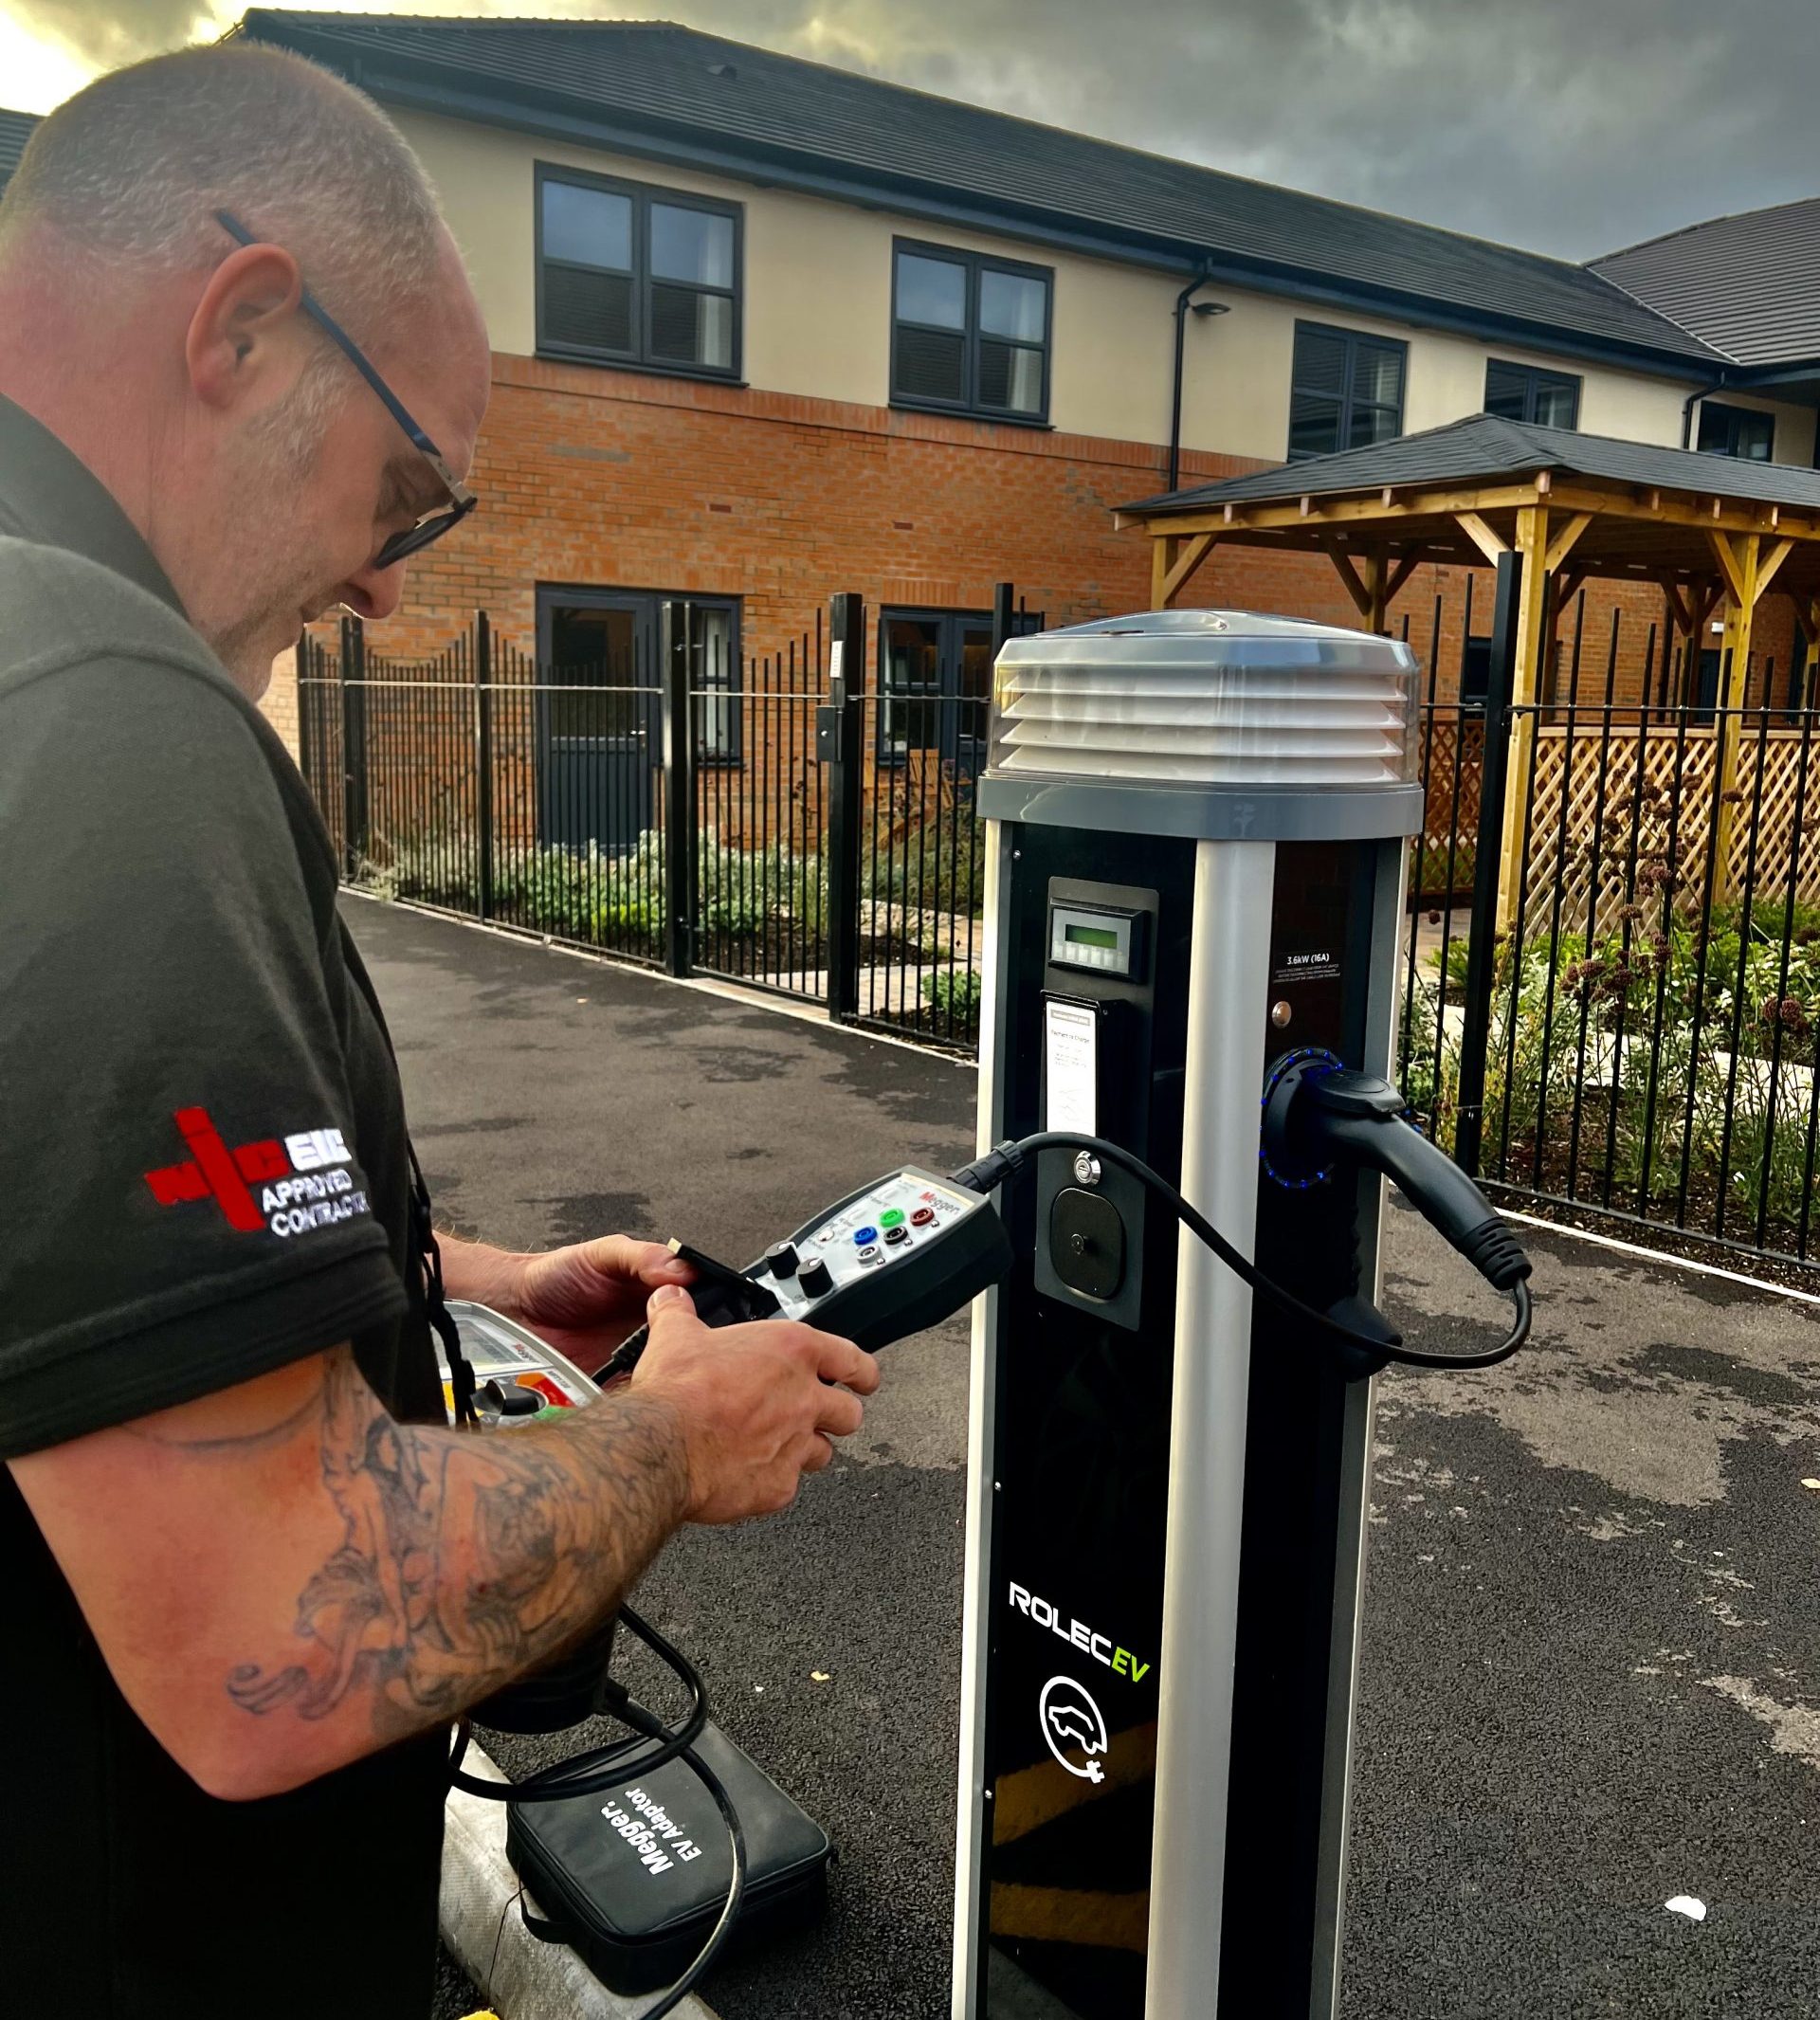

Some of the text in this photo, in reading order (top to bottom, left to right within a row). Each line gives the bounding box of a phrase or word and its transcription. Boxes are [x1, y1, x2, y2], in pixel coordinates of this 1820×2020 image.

[1287, 953, 1330, 965] 3.6kW (16A)
[262, 1169, 354, 1213] APPROVED
[624, 1788, 702, 1862] EV Adaptor
